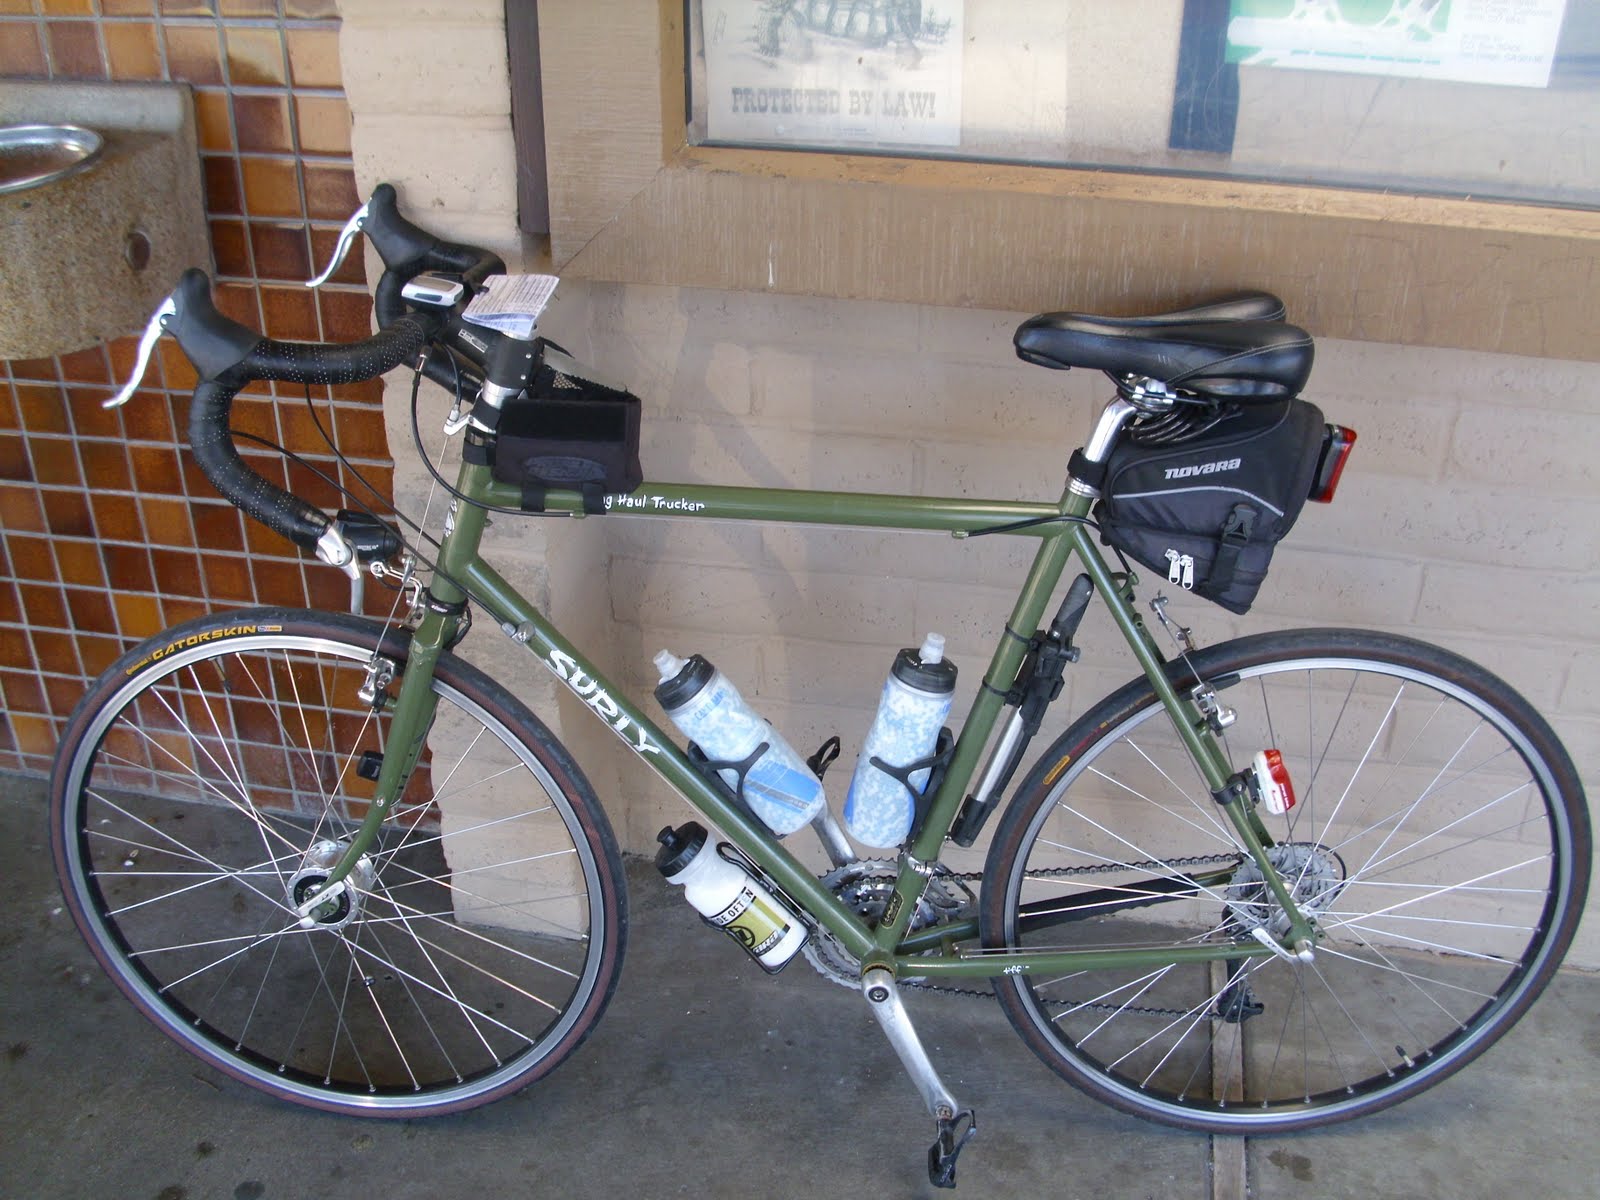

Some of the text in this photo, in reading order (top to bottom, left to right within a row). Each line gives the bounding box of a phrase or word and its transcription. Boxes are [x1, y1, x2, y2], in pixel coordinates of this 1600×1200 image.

[731, 87, 937, 119] PROTECTED BY LAW!
[617, 493, 647, 509] Haul
[650, 496, 705, 512] Trucker
[151, 624, 257, 661] GATORSKIN
[543, 649, 661, 755] SURLY
